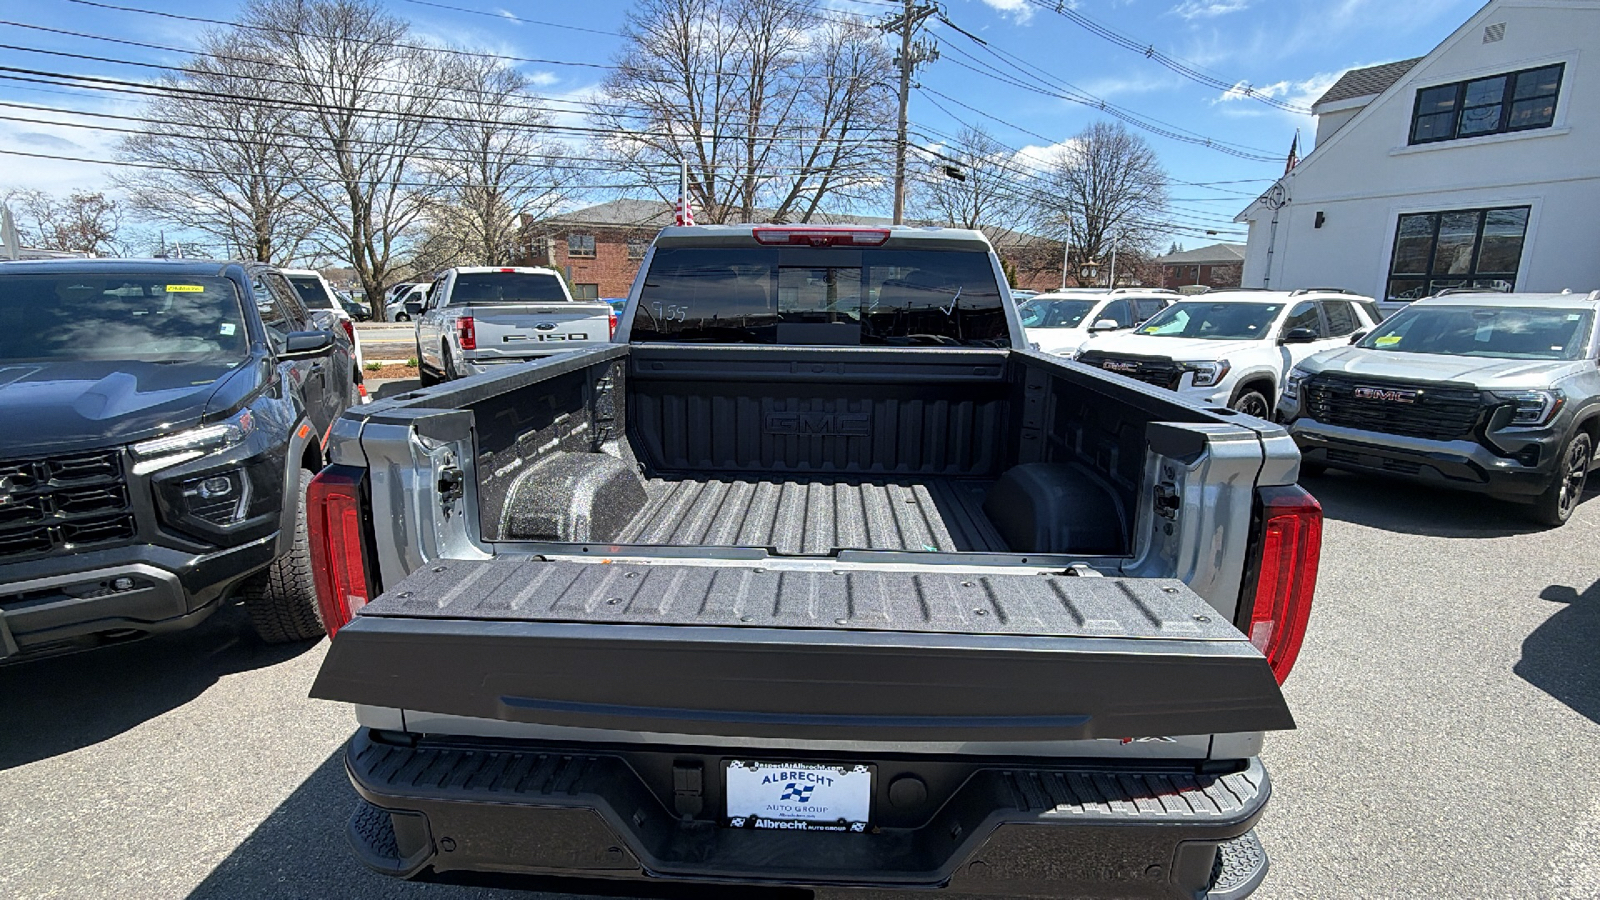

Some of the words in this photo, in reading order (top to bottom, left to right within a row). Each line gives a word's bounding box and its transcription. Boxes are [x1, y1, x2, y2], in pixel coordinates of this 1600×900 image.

[652, 301, 688, 323] 955
[502, 332, 589, 344] F-150
[1354, 387, 1416, 404] GMC
[765, 412, 870, 436] GMC
[761, 771, 834, 787] ALBRECHT
[766, 804, 793, 812] AUTO
[794, 805, 829, 813] GROUP
[754, 818, 808, 831] Albrecht
